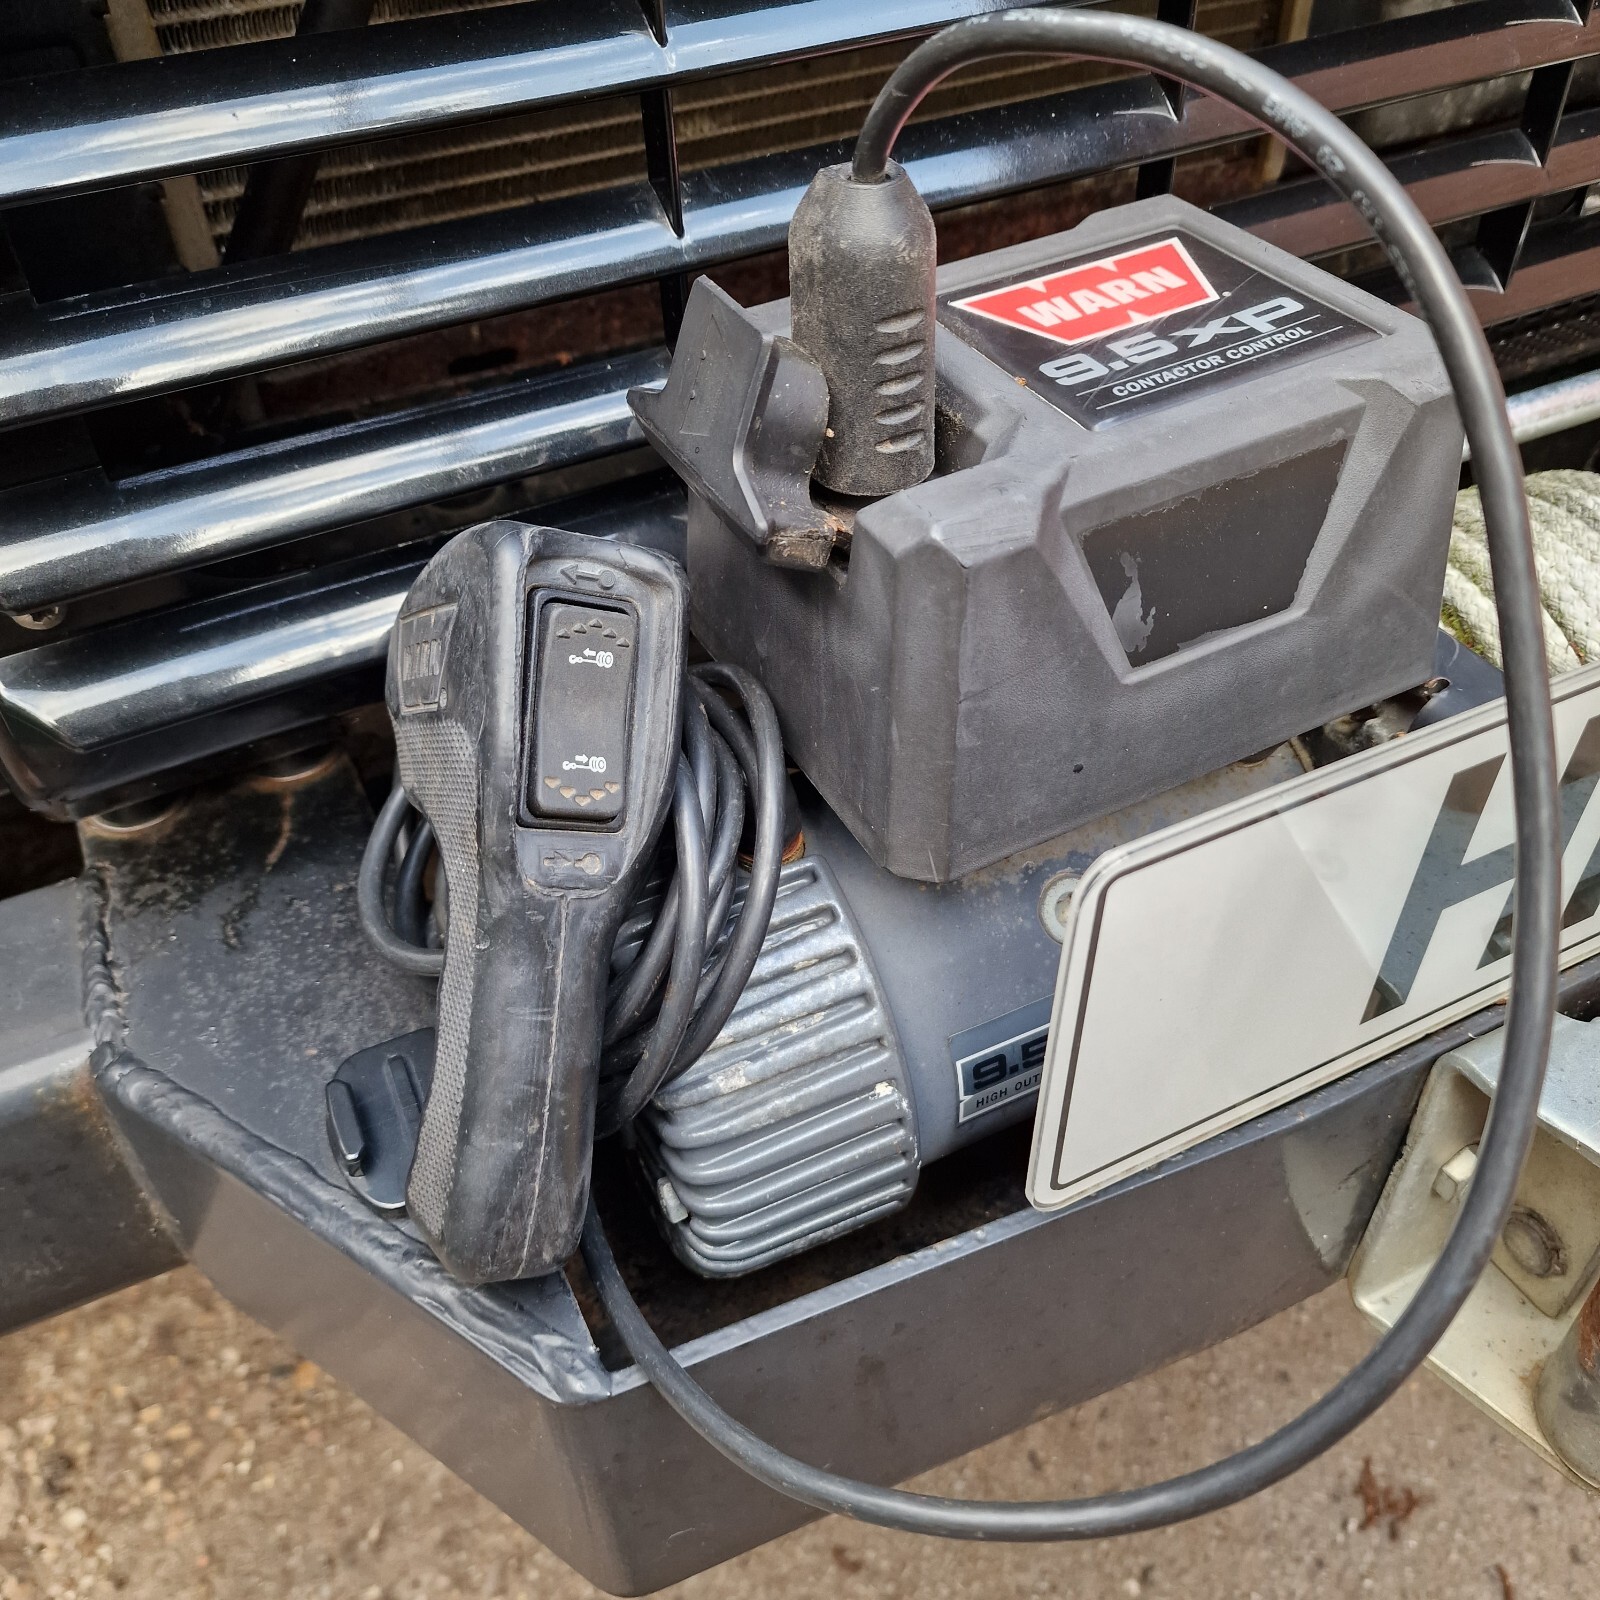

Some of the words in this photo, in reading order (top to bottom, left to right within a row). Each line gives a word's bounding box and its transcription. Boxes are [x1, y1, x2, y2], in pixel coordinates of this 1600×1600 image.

[1016, 265, 1187, 328] WARN
[1112, 355, 1225, 396] CONTACTOR
[1226, 326, 1312, 360] CONTROL
[976, 1088, 1008, 1108] HIGH
[1015, 1072, 1043, 1090] OUT
